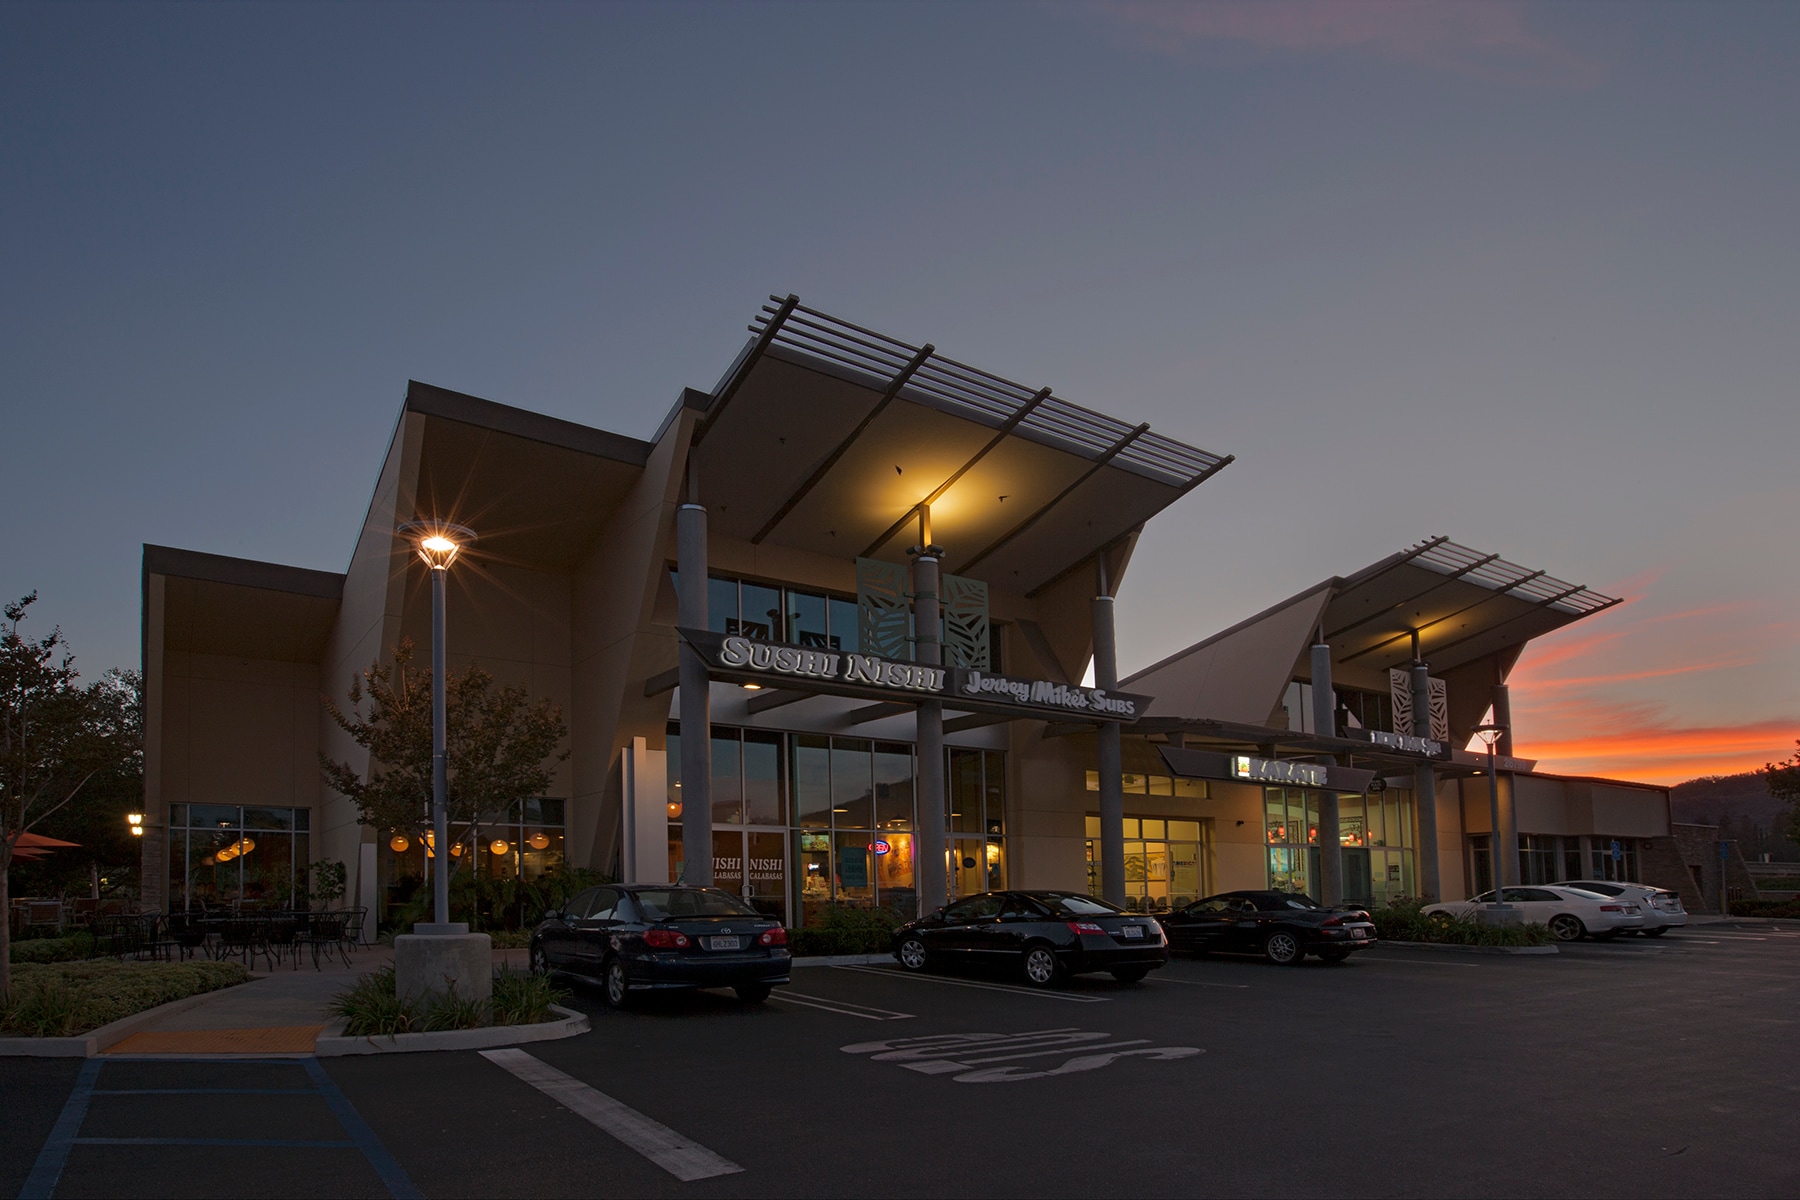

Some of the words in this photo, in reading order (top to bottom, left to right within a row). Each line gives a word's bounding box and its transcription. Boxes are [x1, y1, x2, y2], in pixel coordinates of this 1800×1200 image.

[721, 637, 841, 677] SUSHI
[848, 654, 946, 691] NISHI
[962, 671, 1030, 703] Jersey
[1250, 759, 1328, 784] KARATE
[749, 859, 783, 871] NISHI
[749, 872, 783, 880] CALABASAS
